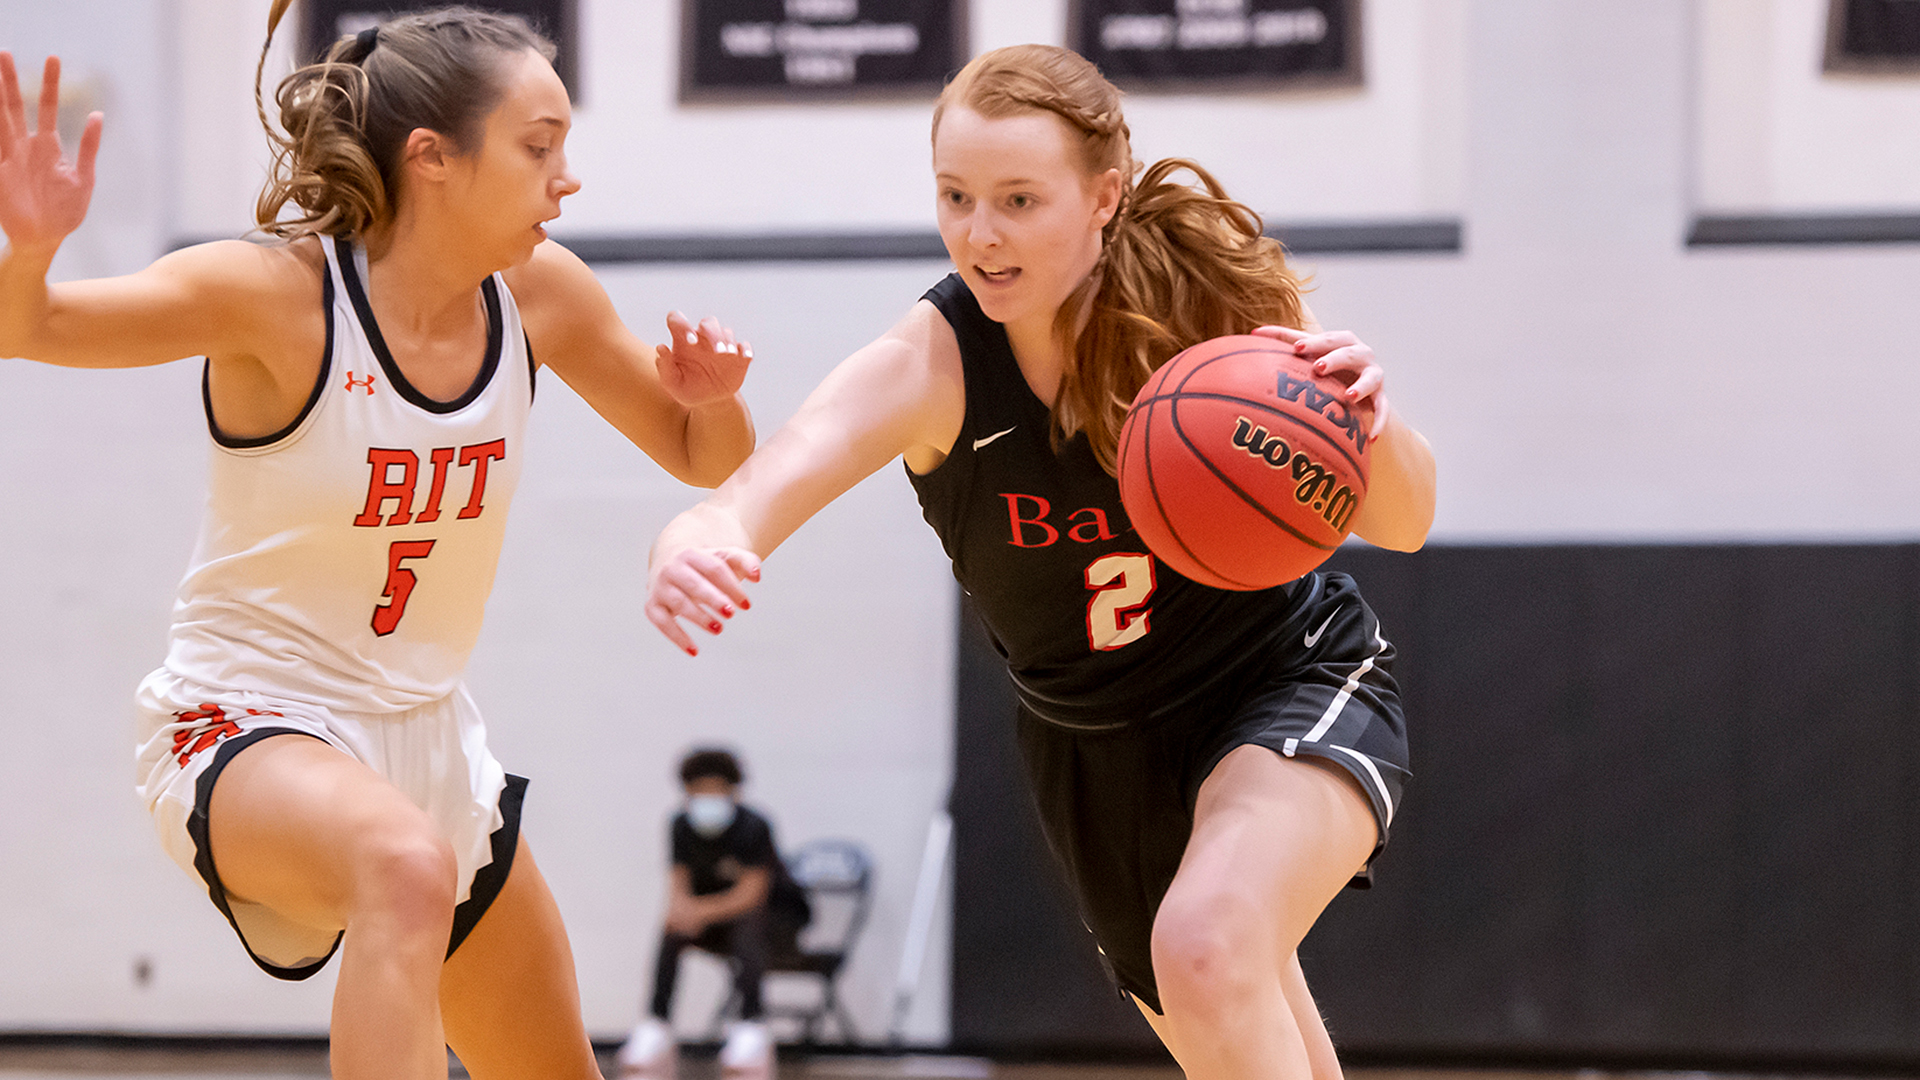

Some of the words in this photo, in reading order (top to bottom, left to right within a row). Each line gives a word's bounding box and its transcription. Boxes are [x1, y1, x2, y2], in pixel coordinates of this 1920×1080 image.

[1277, 371, 1369, 455] NCAA
[353, 438, 505, 527] RIT
[998, 492, 1135, 548] Ba
[1231, 415, 1359, 537] Wilson
[370, 539, 437, 637] 5
[1084, 552, 1158, 652] 2
